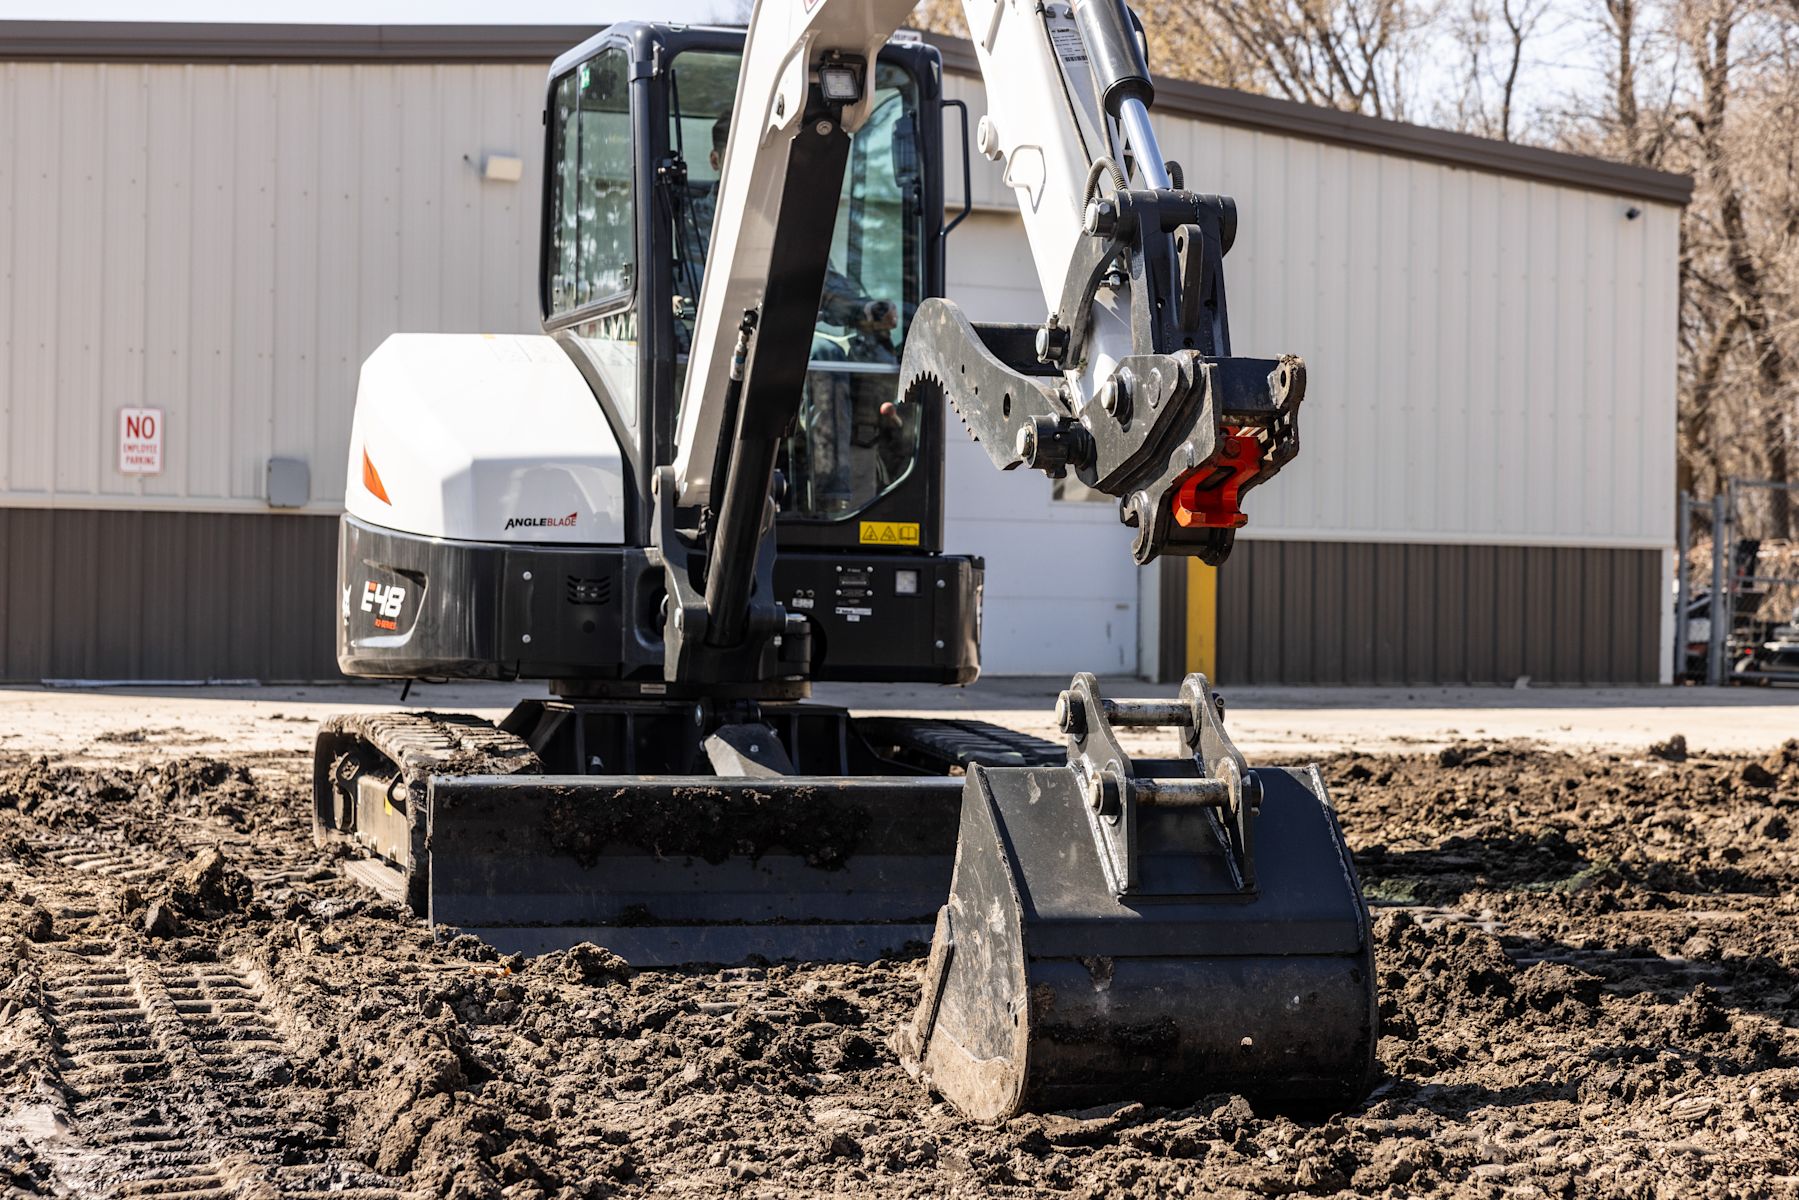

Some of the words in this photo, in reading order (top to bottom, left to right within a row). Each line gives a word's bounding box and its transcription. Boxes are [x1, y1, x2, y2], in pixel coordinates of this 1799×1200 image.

[127, 415, 155, 439] NO
[123, 443, 158, 454] EMPLOYEE
[126, 456, 155, 465] PARKING
[361, 580, 406, 618] E48
